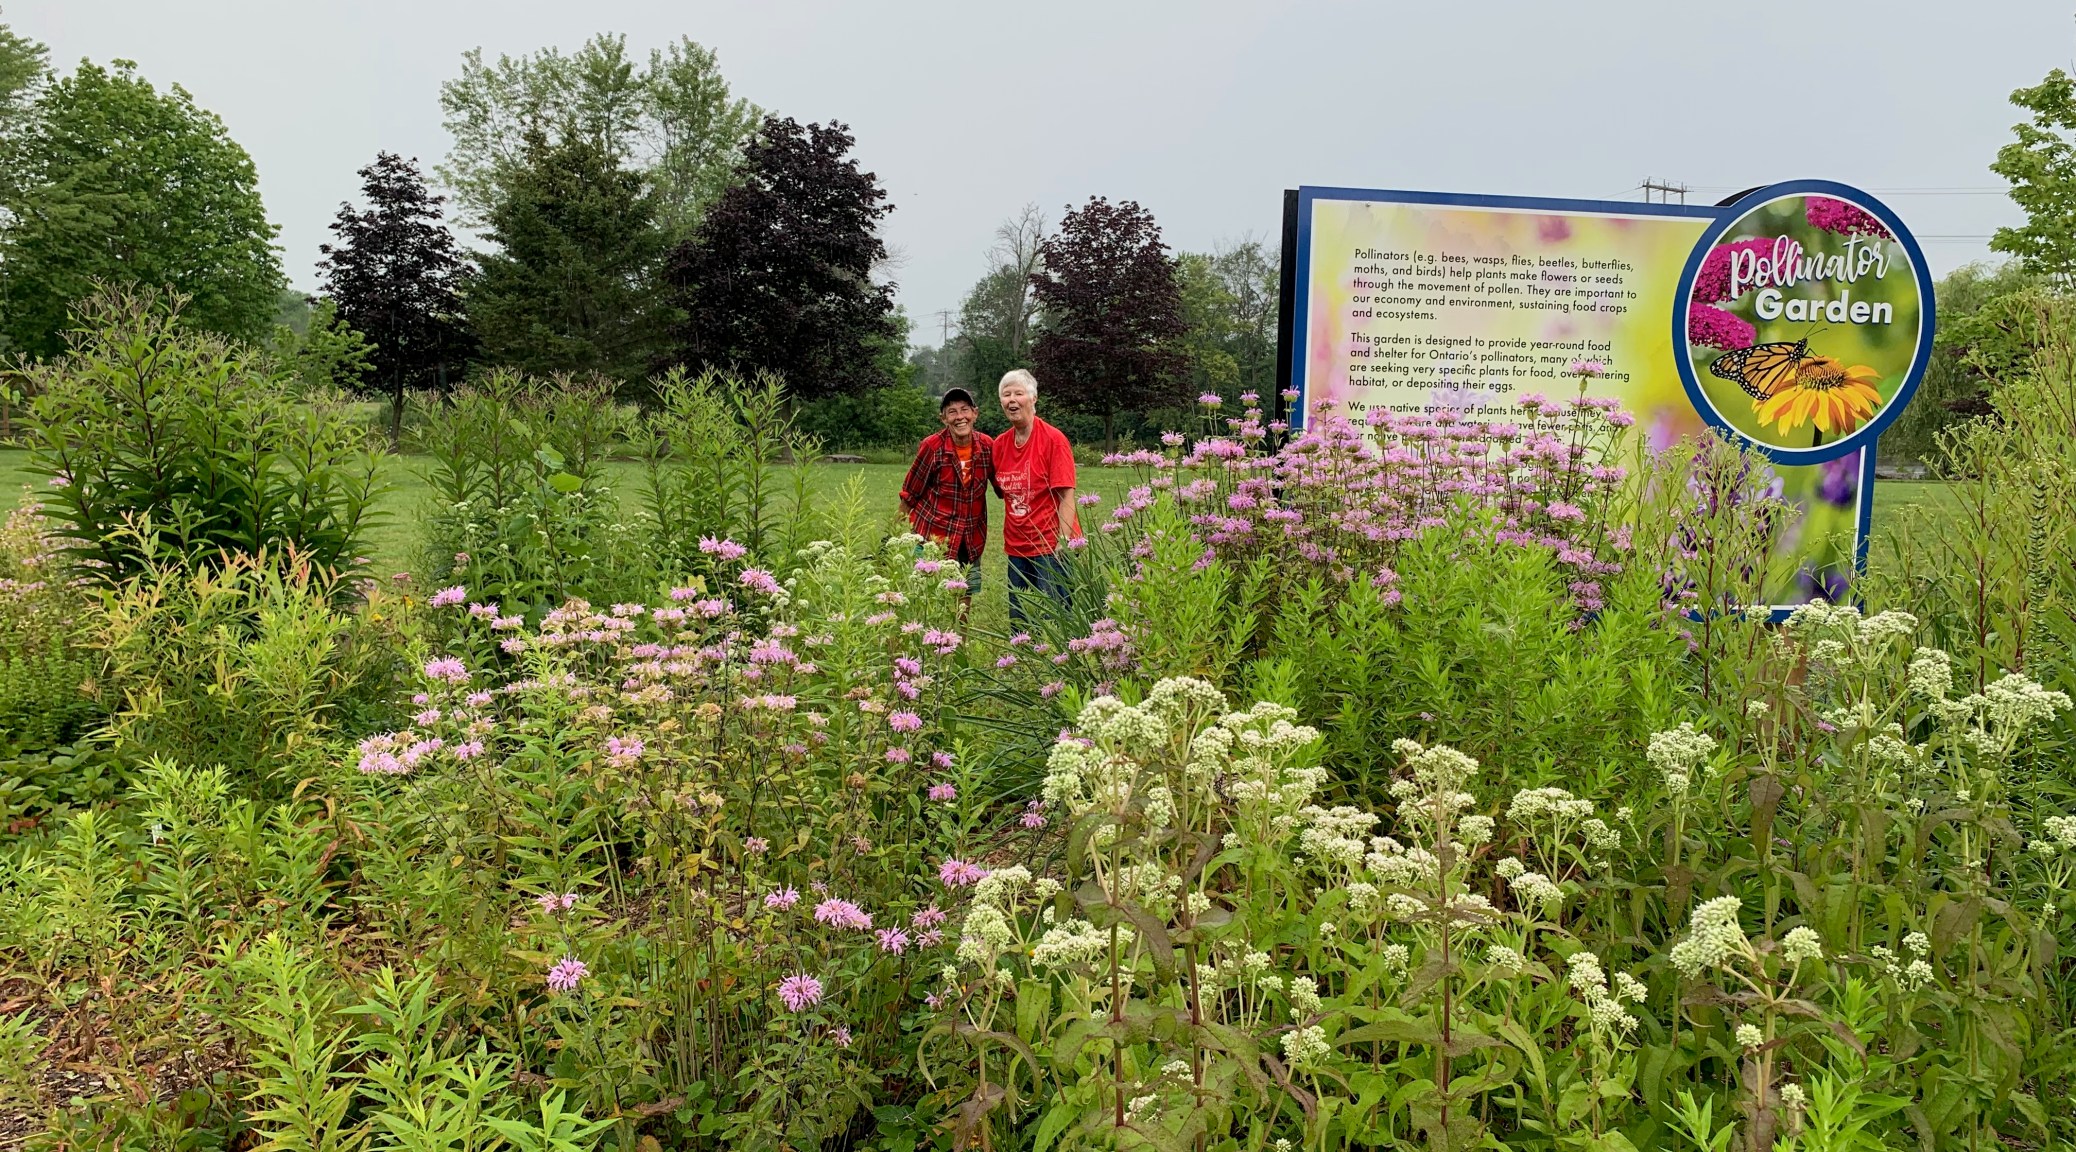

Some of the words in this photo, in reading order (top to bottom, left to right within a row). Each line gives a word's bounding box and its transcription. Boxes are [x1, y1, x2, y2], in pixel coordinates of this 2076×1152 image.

[1355, 248, 1409, 260] Pollinators
[1414, 250, 1437, 264] (e.g.
[1442, 252, 1468, 265] bees,
[1473, 257, 1507, 267] wasps,
[1512, 254, 1534, 267] flies,
[1539, 256, 1577, 269] beetles,
[1582, 258, 1633, 272] butterflies,
[1730, 231, 1891, 300] Pollinator
[1354, 263, 1387, 276] moths,
[1392, 265, 1412, 275] and
[1416, 265, 1445, 279] birds)
[1450, 266, 1472, 280] help
[1476, 268, 1506, 281] plants
[1510, 270, 1537, 280] make
[1541, 270, 1577, 282] flowers
[1581, 276, 1592, 284] or
[1595, 274, 1623, 284] seeds
[1354, 277, 1394, 292] through
[1398, 279, 1413, 290] the
[1418, 284, 1470, 293] movement
[1474, 282, 1485, 292] of
[1488, 283, 1522, 296] pollen.
[1527, 284, 1551, 298] They
[1554, 289, 1571, 297] are
[1575, 287, 1624, 300] important
[1627, 290, 1636, 299] to
[1352, 307, 1372, 317] and
[1376, 310, 1437, 321] ecosystems.
[1353, 296, 1370, 304] our
[1374, 297, 1421, 308] economy
[1426, 295, 1445, 305] and
[1449, 297, 1514, 310] environment,
[1520, 300, 1570, 313] sustaining
[1573, 300, 1596, 311] food
[1600, 305, 1627, 315] crops
[1755, 289, 1893, 325] Garden
[1351, 332, 1370, 343] This
[1374, 333, 1410, 346] garden
[1415, 335, 1421, 344] is
[1426, 334, 1471, 348] designed
[1475, 338, 1484, 347] to
[1488, 337, 1526, 350] provide
[1530, 340, 1584, 351] year-round
[1588, 340, 1610, 351] food
[1351, 347, 1370, 357] and
[1374, 347, 1408, 358] shelter
[1411, 348, 1426, 359] for
[1429, 350, 1477, 360] Ontario's
[1481, 351, 1536, 364] pollinators,
[1541, 357, 1568, 366] many
[1350, 365, 1367, 373] are
[1371, 362, 1409, 376] seeking
[1413, 367, 1435, 376] very
[1439, 364, 1476, 377] specific
[1479, 365, 1509, 378] plants
[1513, 366, 1527, 376] for
[1530, 366, 1556, 379] food,
[1349, 375, 1387, 389] habitat,
[1392, 380, 1403, 388] or
[1407, 377, 1459, 392] depositing
[1463, 378, 1485, 389] their
[1489, 383, 1515, 393] eggs.
[1348, 401, 1366, 412] We
[1390, 402, 1420, 412] native
[1463, 403, 1475, 414] of
[1477, 404, 1507, 417] plants
[1537, 420, 1565, 430] fewer
